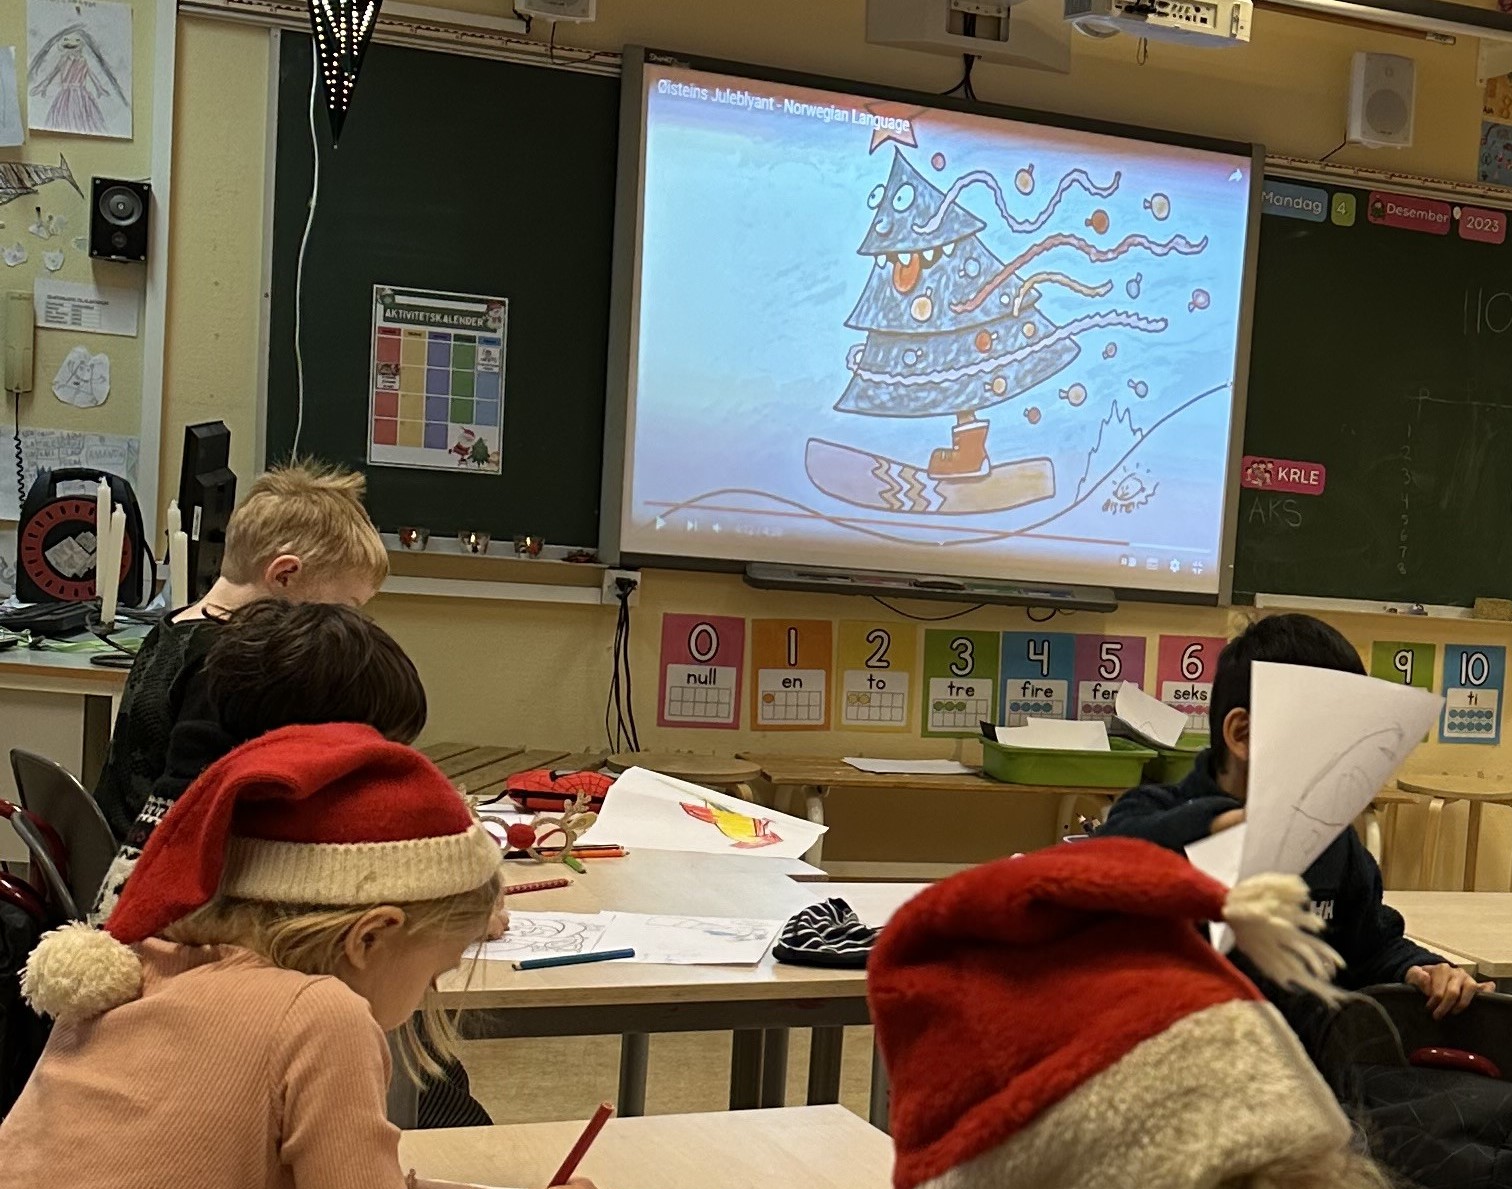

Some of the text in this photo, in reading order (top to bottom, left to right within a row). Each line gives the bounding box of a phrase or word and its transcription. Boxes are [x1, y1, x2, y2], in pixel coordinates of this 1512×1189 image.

[658, 78, 708, 101] Øisteins
[711, 88, 775, 112] Juleblyant
[783, 98, 849, 123] Norwegian
[851, 109, 912, 134] Language
[1262, 190, 1322, 215] Mandag
[1386, 202, 1449, 224] Desember
[1466, 215, 1500, 233] 2023
[384, 308, 484, 328] AKTIVITETSKALENDER
[1277, 466, 1321, 486] KRLE
[1248, 496, 1303, 528] AKS
[688, 622, 720, 664] 0
[787, 626, 798, 668] 1
[865, 629, 891, 670] 2
[949, 636, 975, 678] 3
[1027, 639, 1051, 678] 4
[1099, 641, 1123, 681] 5
[1180, 642, 1205, 681] 6
[687, 667, 717, 686] null
[782, 675, 802, 689] en
[867, 674, 886, 690] to
[1394, 649, 1415, 686] 9
[1459, 650, 1490, 687] 10
[948, 681, 975, 698] tre
[1021, 681, 1054, 699] fire
[1173, 686, 1208, 701] seks
[1467, 690, 1479, 706] ti
